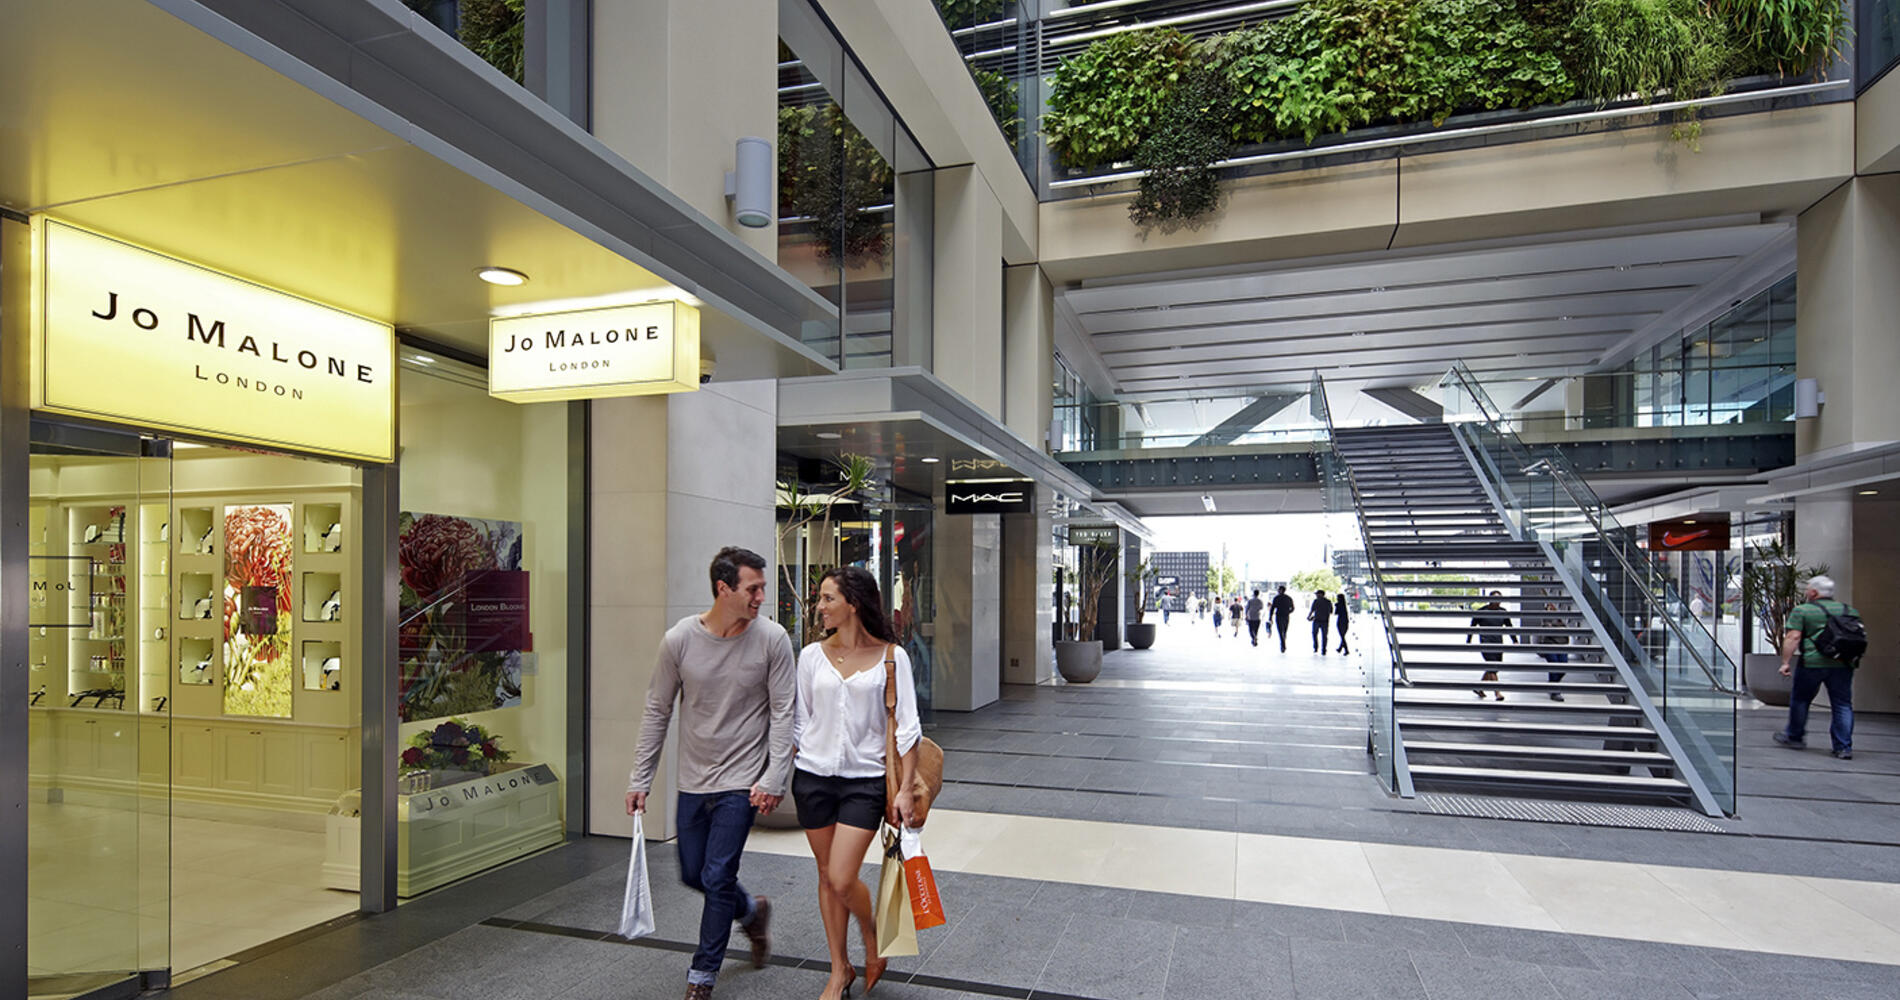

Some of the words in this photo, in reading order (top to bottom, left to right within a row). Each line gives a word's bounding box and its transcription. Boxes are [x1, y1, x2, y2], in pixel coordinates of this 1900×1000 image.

[545, 325, 659, 349] MALONE
[187, 312, 374, 384] MALONE
[549, 358, 611, 372] LONDON
[194, 364, 304, 400] LONDON
[951, 492, 1024, 504] MAC
[471, 603, 498, 611] LONDON
